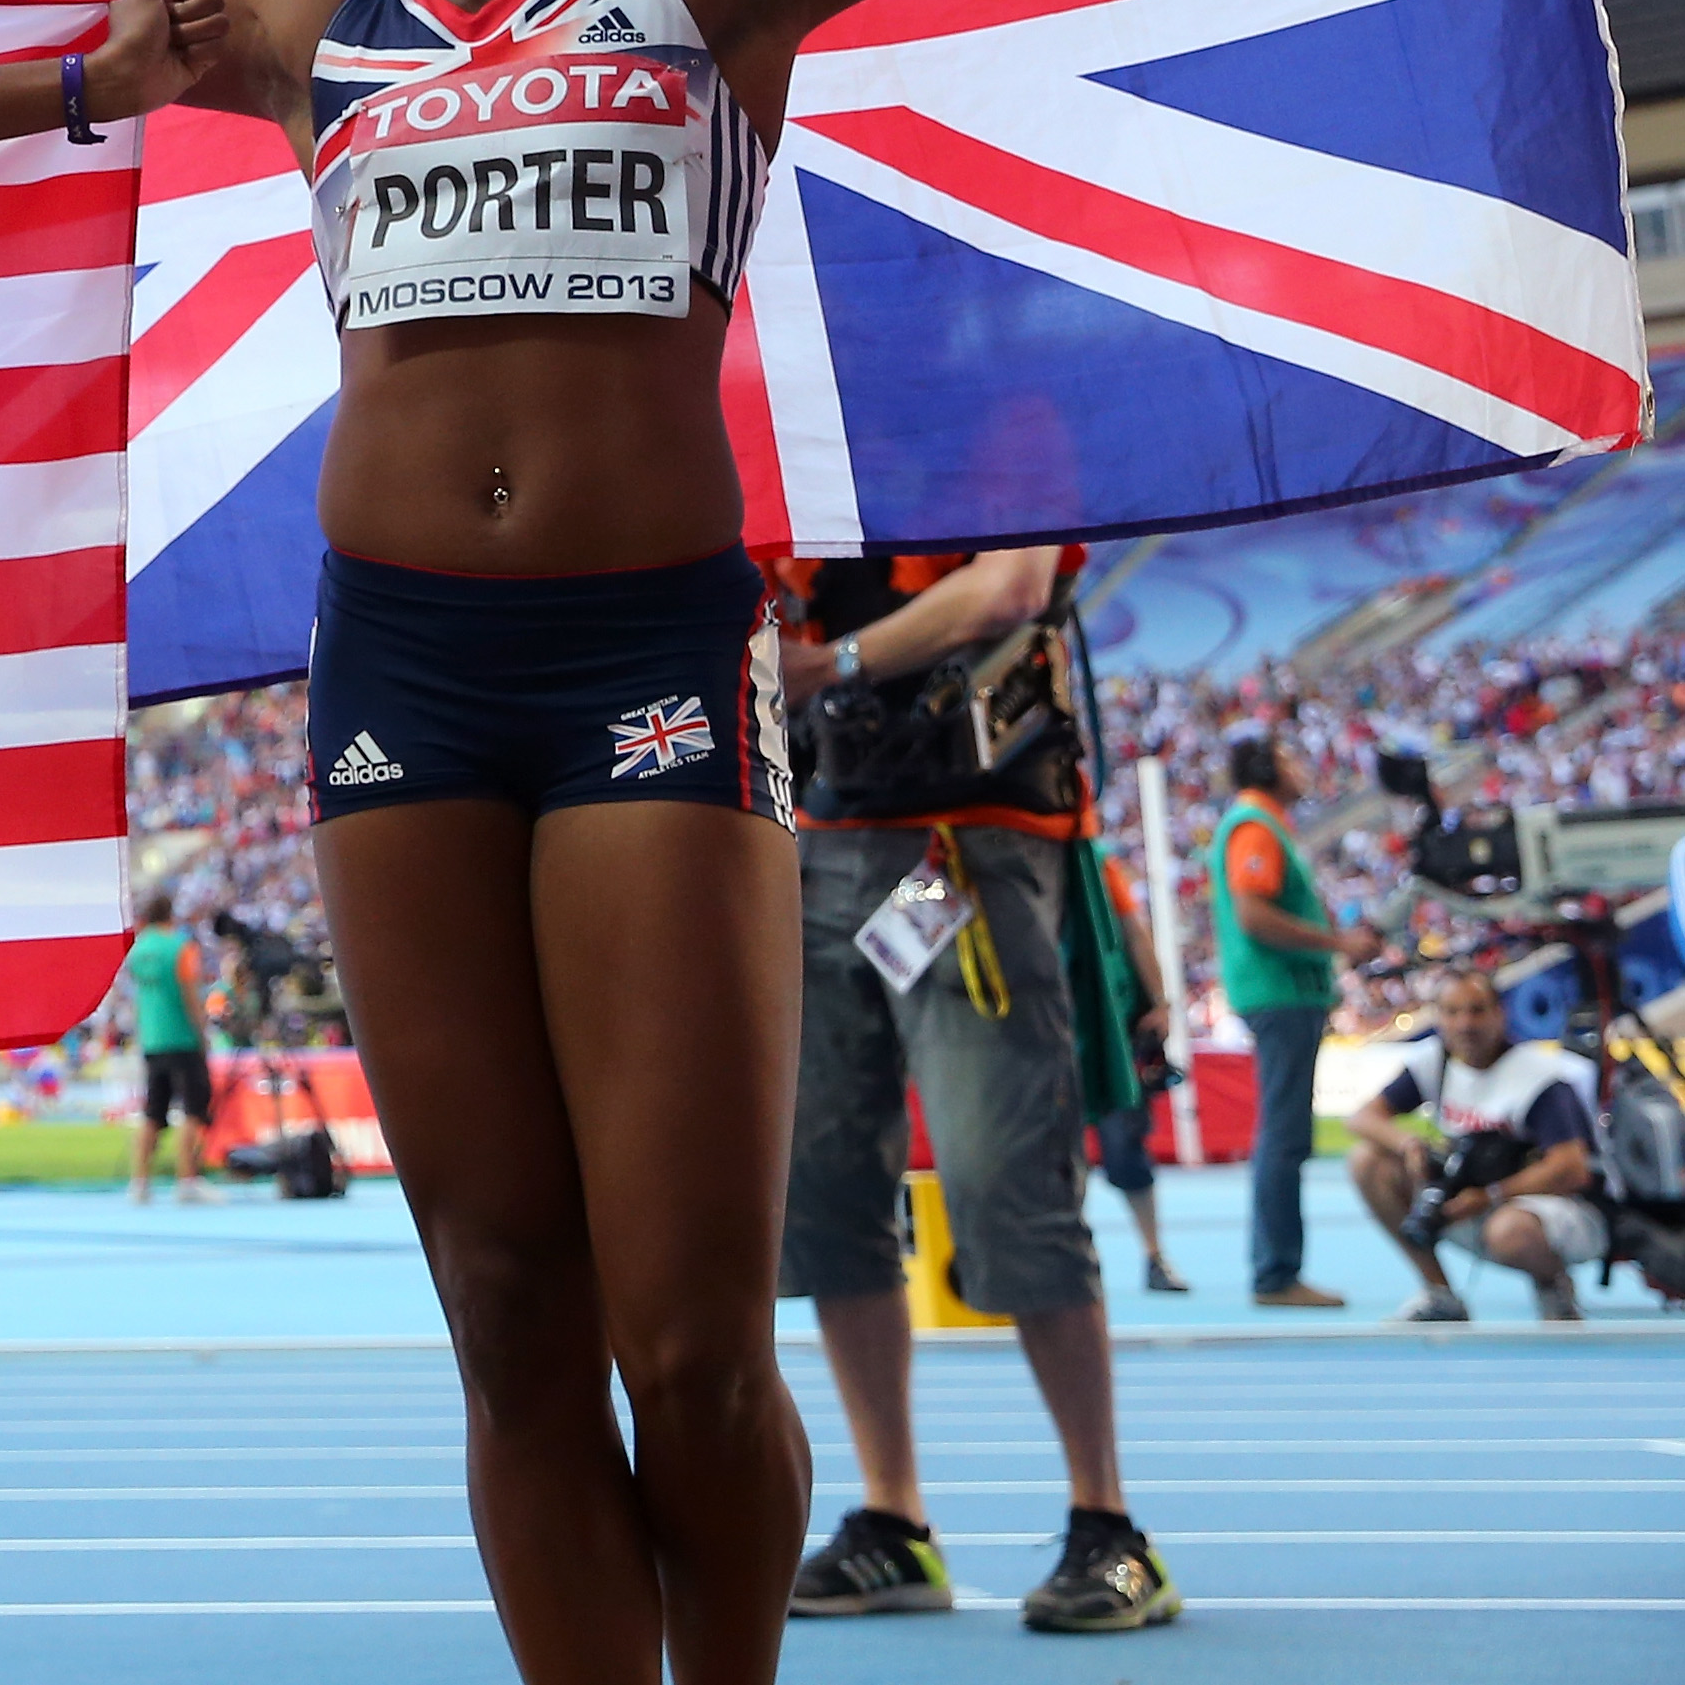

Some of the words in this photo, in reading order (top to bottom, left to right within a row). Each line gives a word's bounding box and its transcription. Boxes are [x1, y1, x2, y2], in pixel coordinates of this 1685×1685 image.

[579, 27, 647, 45] adidas
[366, 64, 671, 140] TOYOTA
[371, 149, 670, 248] PORTER
[359, 273, 554, 317] MOSCOW
[566, 272, 676, 303] 2013
[620, 706, 646, 721] GREAT
[329, 762, 404, 785] adidas
[637, 756, 684, 780] ATHLETICS
[685, 751, 709, 763] TEAM
